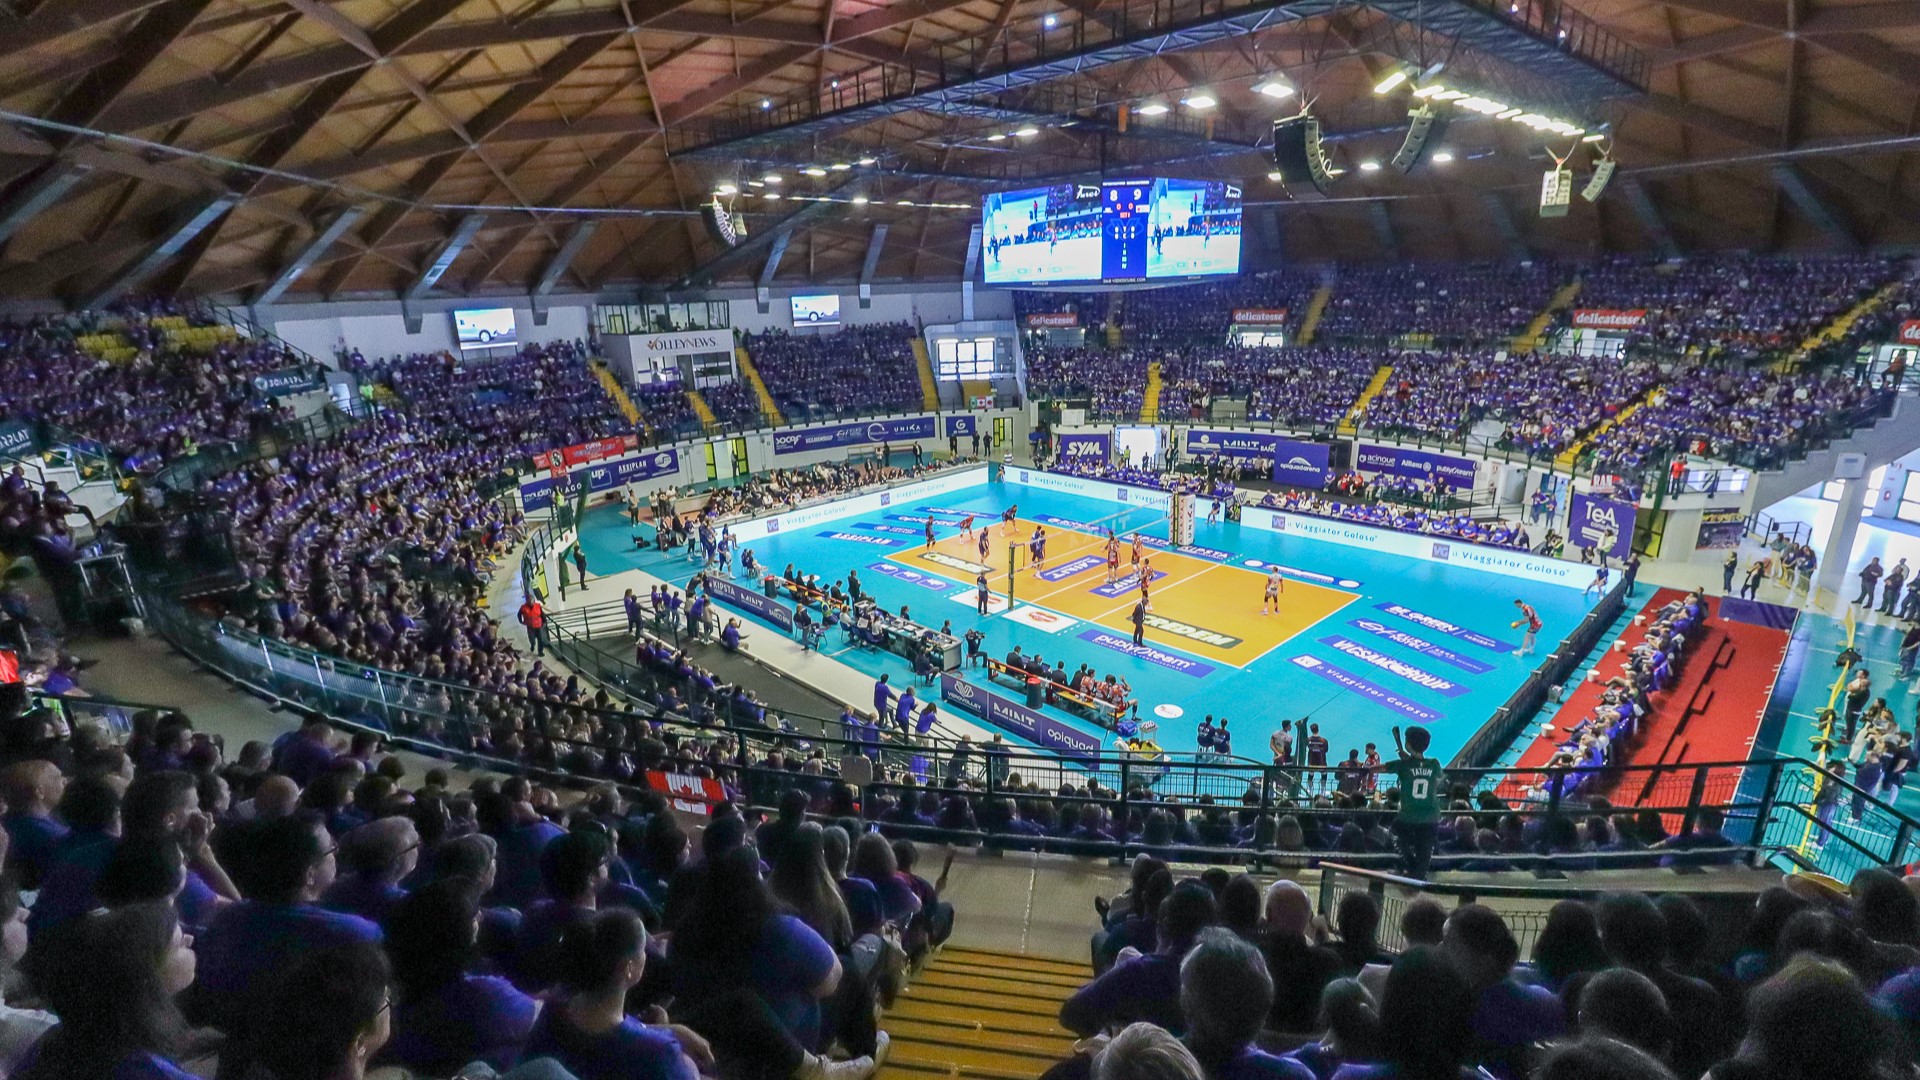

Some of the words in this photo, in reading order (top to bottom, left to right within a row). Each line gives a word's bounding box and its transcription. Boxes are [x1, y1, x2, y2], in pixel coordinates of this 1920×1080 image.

[1110, 190, 1118, 202] 8
[1133, 188, 1142, 201] 9
[1116, 203, 1122, 211] 0
[1128, 202, 1134, 211] 0
[1235, 312, 1285, 322] delicatesse
[647, 336, 716, 351] VOLLEYNEWS
[893, 424, 921, 432] UNIKA
[1066, 442, 1103, 457] SYM
[1223, 440, 1259, 448] MINT
[1401, 460, 1422, 469] Allianz
[1295, 522, 1341, 535] Viaggiator
[1343, 531, 1376, 542] Goloso
[1462, 552, 1521, 568] Viaggiator
[1525, 562, 1566, 577] Goloso
[713, 580, 736, 596] KIPSTA
[1326, 669, 1384, 698] Viaggiator
[1387, 696, 1431, 719] Goloso
[993, 702, 1036, 726] MINT
[1047, 728, 1094, 750] opiquad
[1411, 768, 1434, 778] TATUM
[1412, 778, 1429, 800] 0
